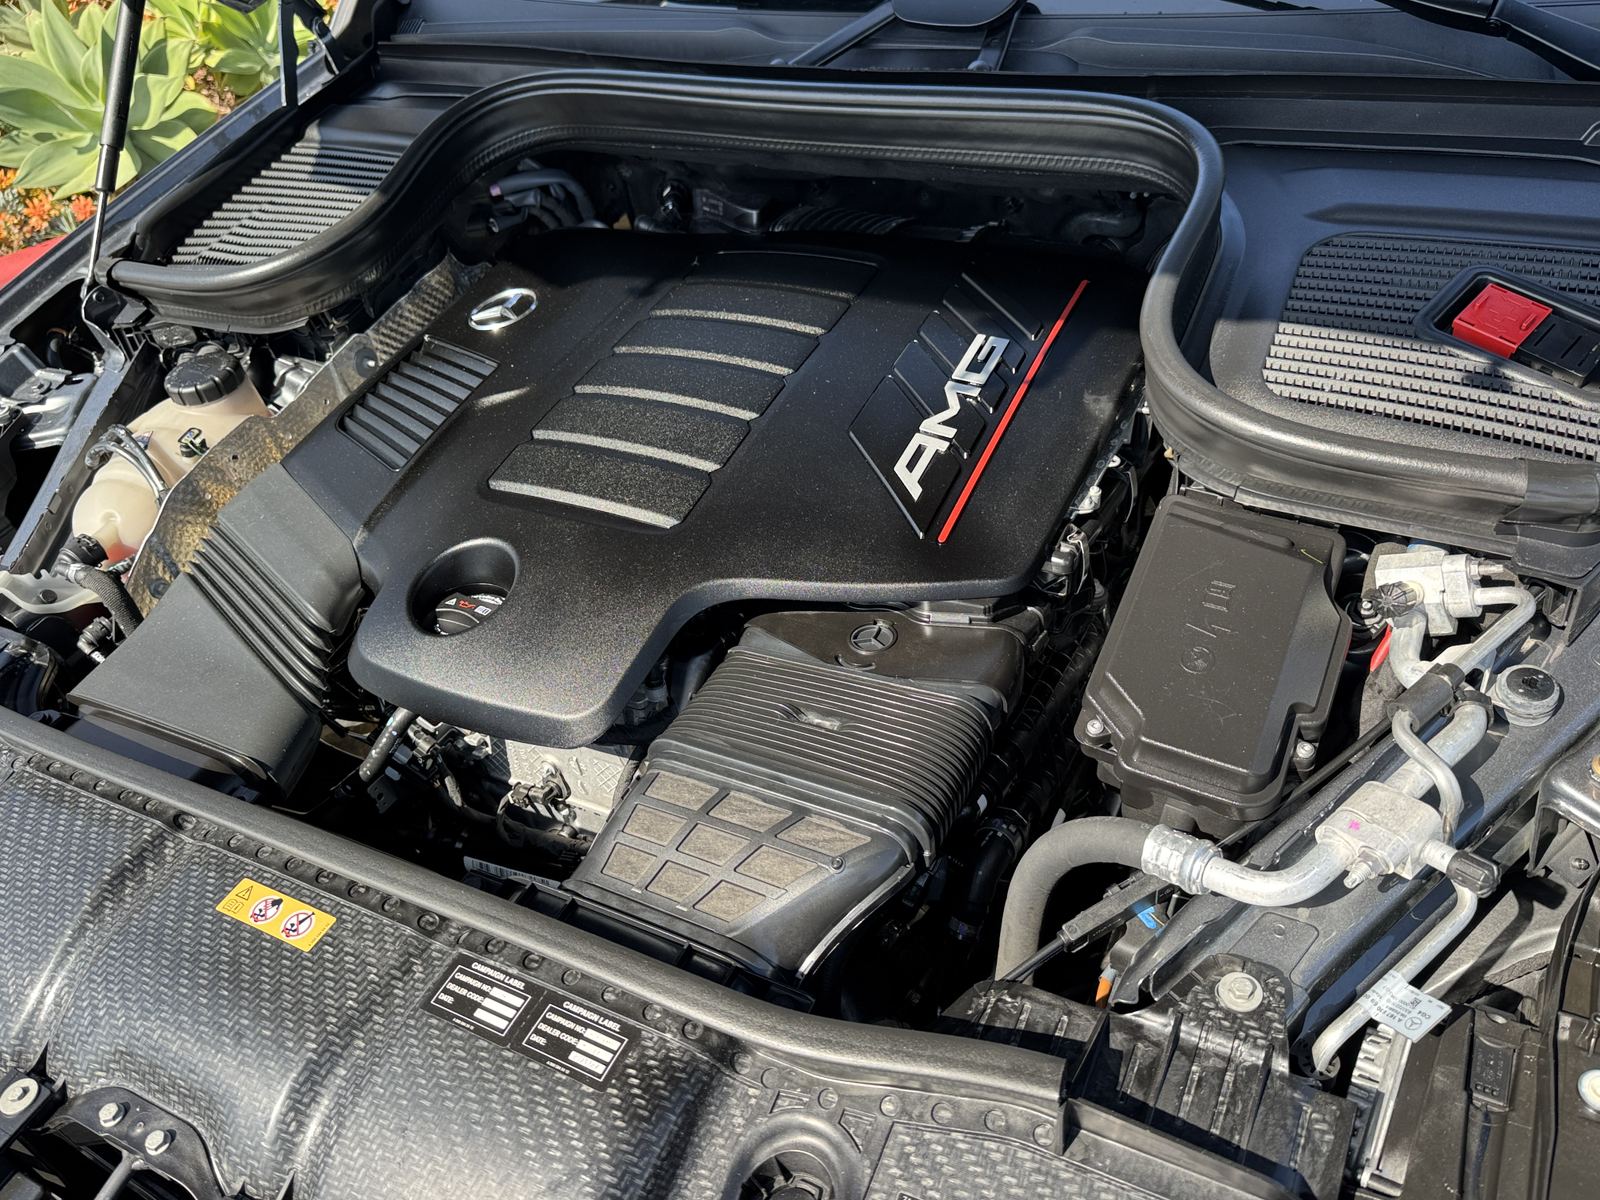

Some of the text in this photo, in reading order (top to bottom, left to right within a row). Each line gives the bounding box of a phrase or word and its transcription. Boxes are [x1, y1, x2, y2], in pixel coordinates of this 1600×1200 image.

[894, 334, 1010, 502] AMG
[455, 973, 482, 988] CAMPAIGN
[472, 962, 526, 989] CAMPAIGN LABEL
[446, 982, 467, 995] DEALER
[546, 1012, 575, 1028] CAMPAIGN
[563, 1001, 621, 1031] CAMPAIGN LABEL
[1417, 1010, 1431, 1019] CG4
[538, 1022, 560, 1036] DEALER
